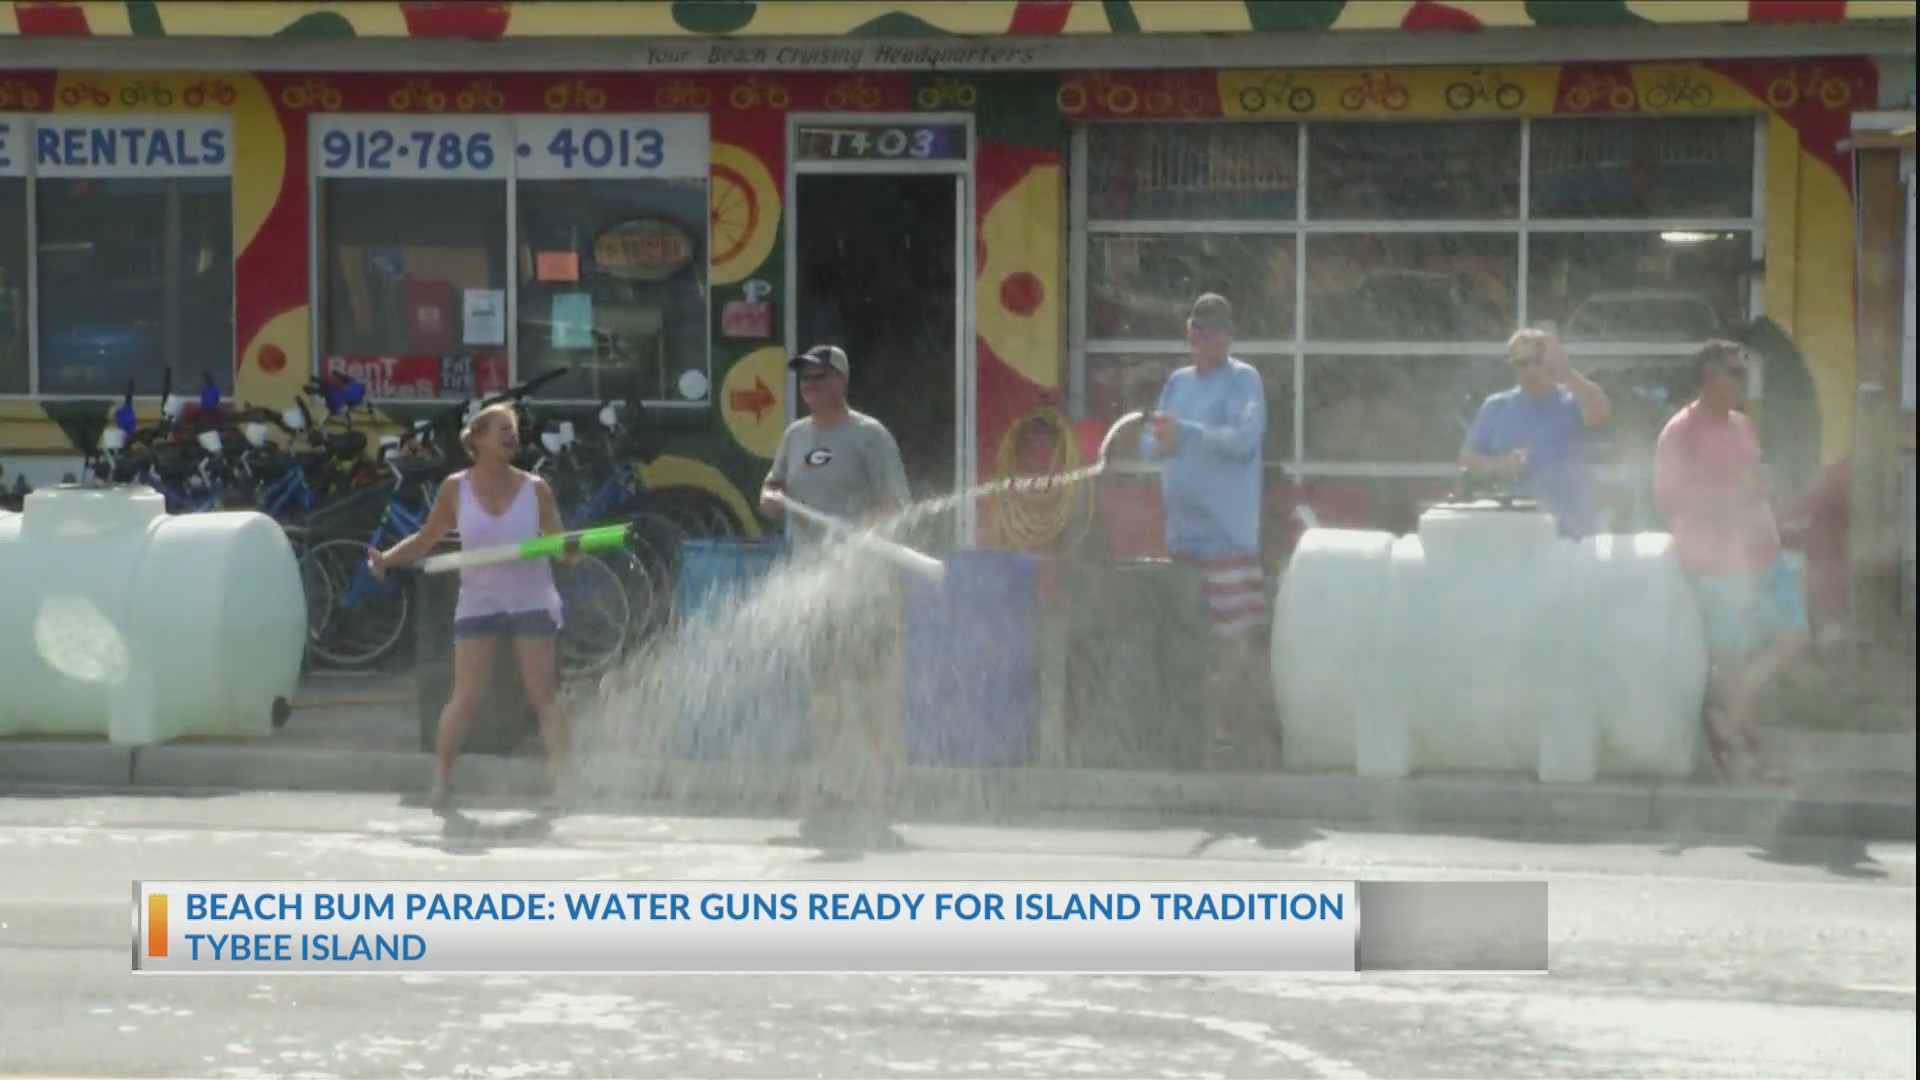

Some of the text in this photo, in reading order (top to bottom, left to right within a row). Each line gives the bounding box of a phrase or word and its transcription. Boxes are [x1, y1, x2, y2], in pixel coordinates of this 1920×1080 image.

[647, 46, 691, 65] Your
[707, 46, 767, 64] Beach
[776, 47, 862, 69] Cruising
[37, 127, 225, 166] RENTALS
[830, 128, 935, 157] 1403
[805, 449, 832, 467] G
